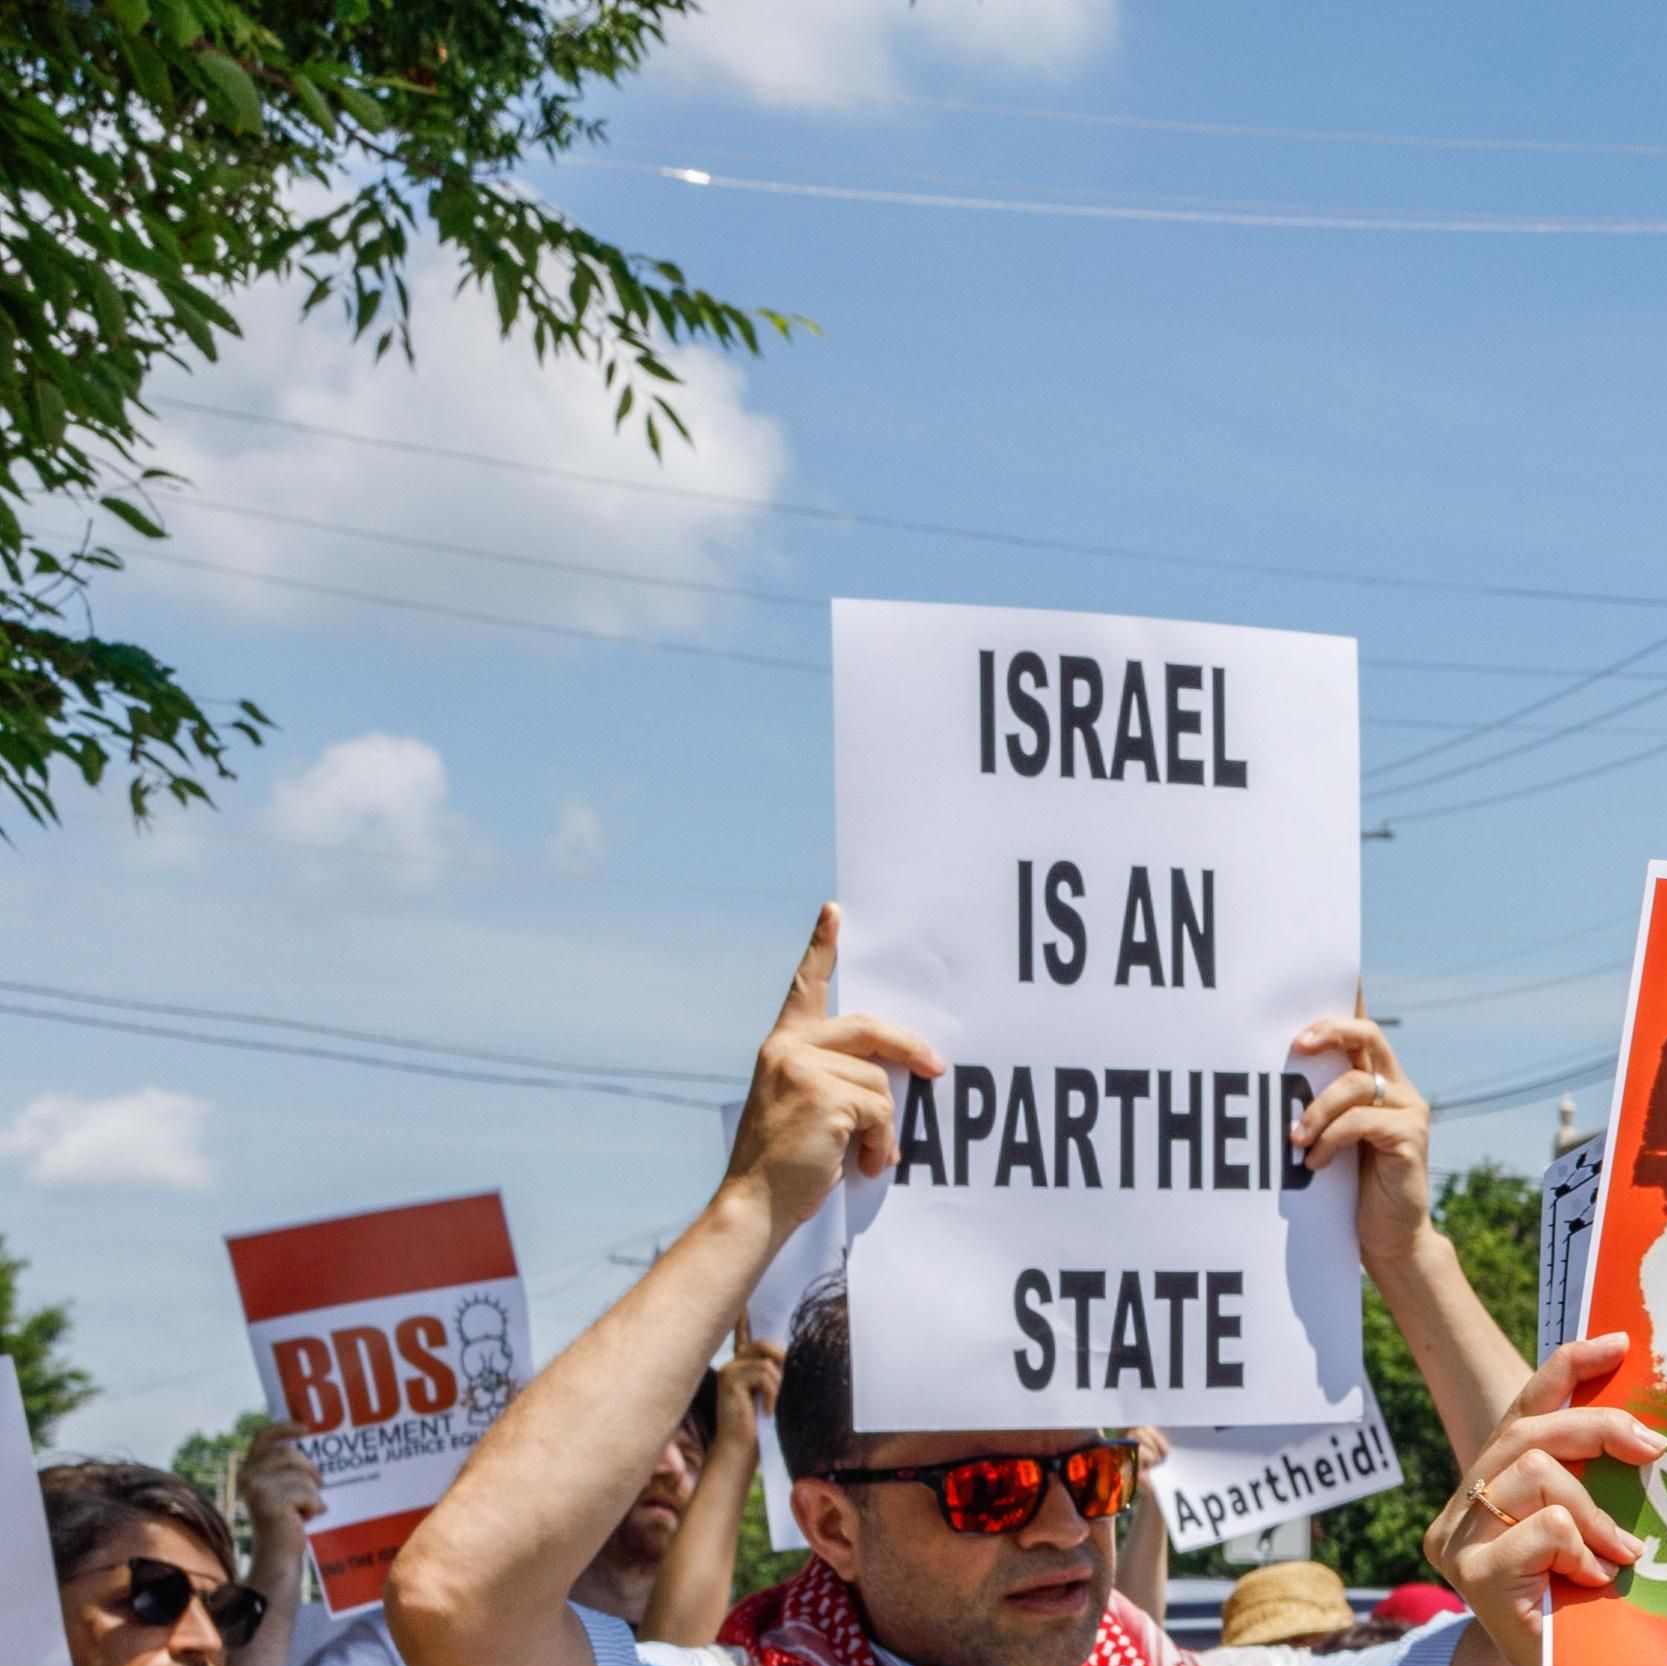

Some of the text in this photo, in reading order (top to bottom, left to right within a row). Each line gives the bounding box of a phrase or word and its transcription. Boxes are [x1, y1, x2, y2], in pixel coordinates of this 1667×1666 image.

[979, 649, 1248, 788] ISRAEL
[1017, 860, 1217, 989] IS AN
[894, 1064, 1315, 1191] APARTHEID
[271, 1315, 457, 1436] BDS
[1014, 1269, 1244, 1391] STATE
[296, 1415, 452, 1459] MOVEMENT
[319, 1453, 378, 1474] EEDOM
[385, 1437, 445, 1462] JUSTICE
[1174, 1425, 1389, 1537] Apartheid!
